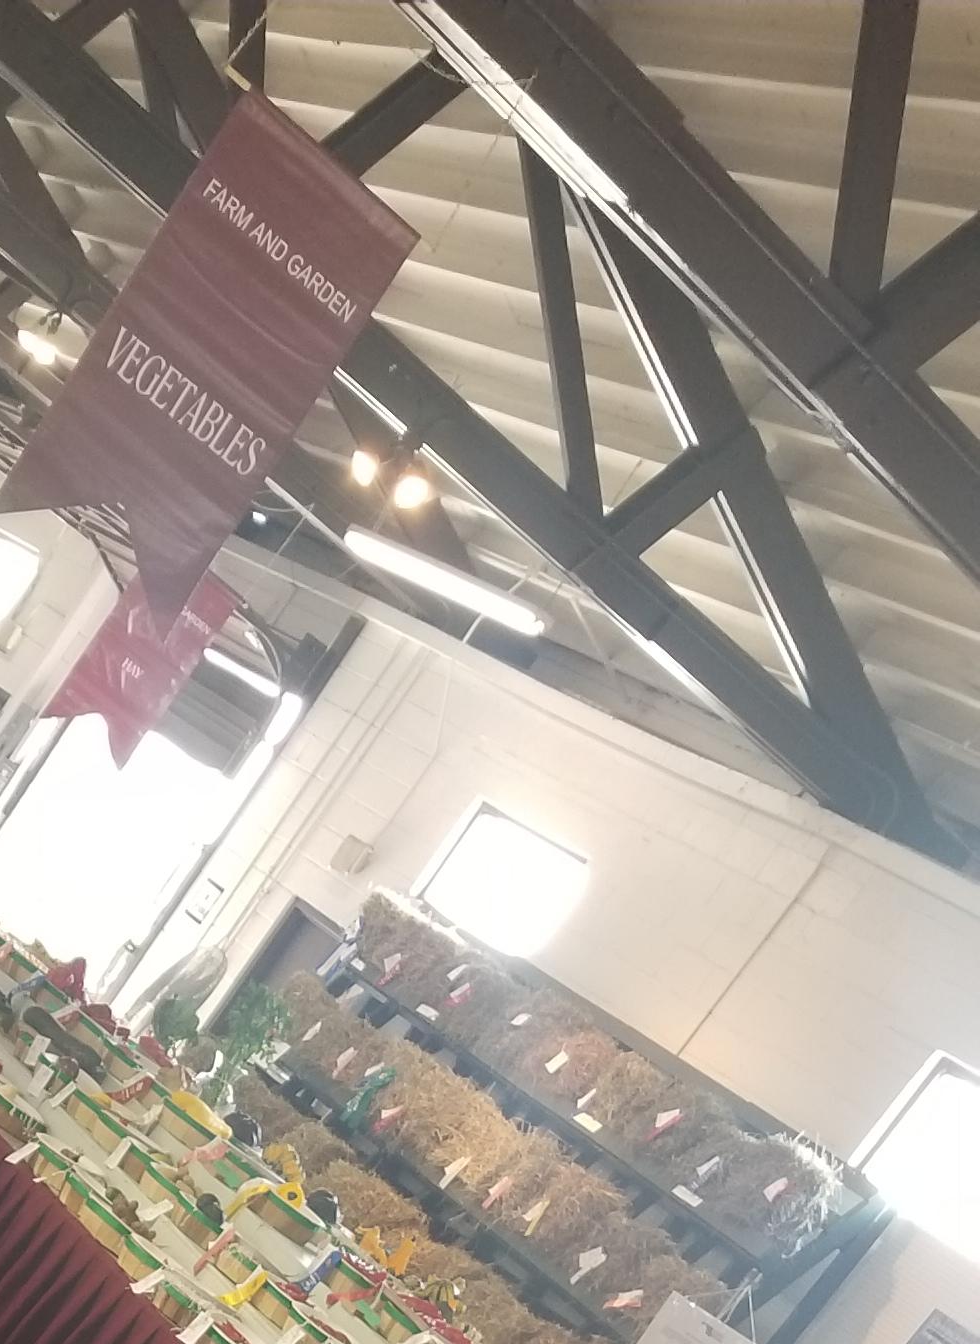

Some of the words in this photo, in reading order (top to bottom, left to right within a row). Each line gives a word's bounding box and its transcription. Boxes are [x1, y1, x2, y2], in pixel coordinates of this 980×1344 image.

[203, 178, 255, 233] FARM
[249, 216, 288, 262] AND
[286, 254, 358, 324] GARDEN
[105, 326, 268, 477] VEGETABLES
[121, 655, 146, 680] HAY
